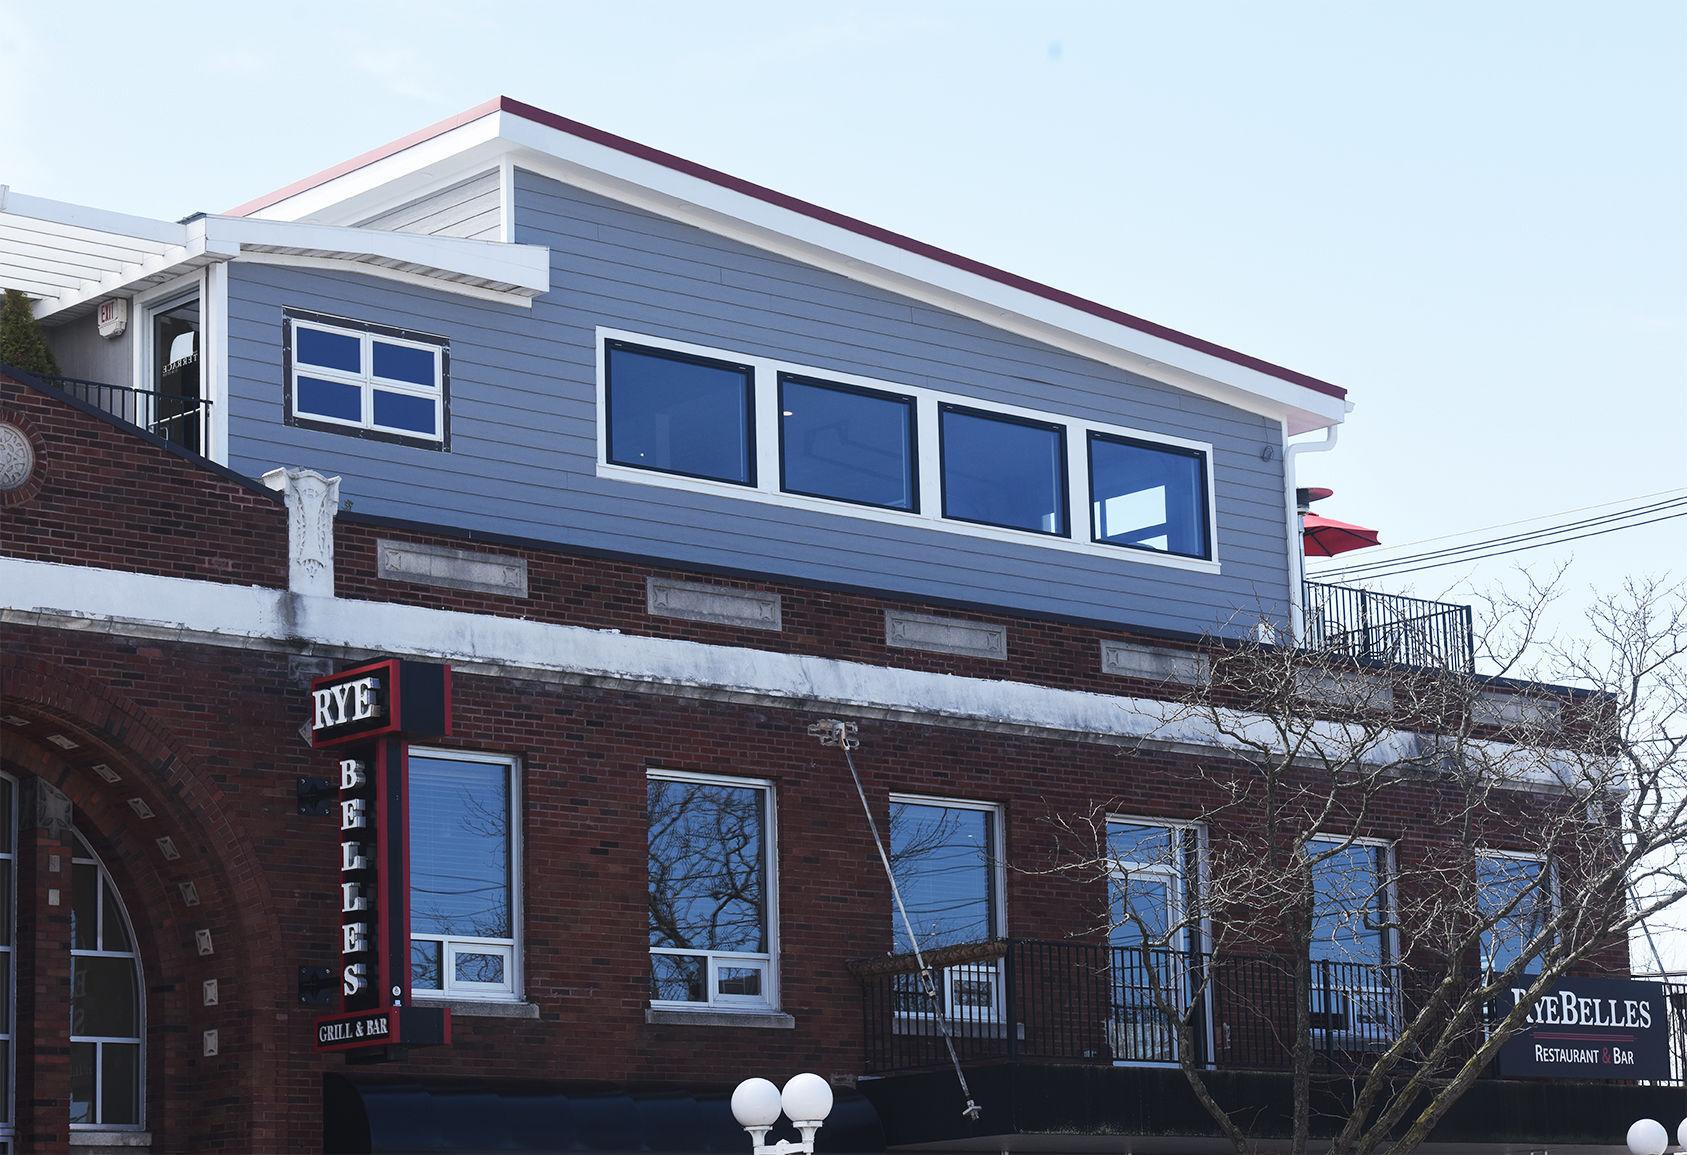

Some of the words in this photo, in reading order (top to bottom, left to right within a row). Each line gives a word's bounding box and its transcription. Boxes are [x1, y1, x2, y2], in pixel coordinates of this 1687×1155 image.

[101, 302, 114, 323] EXIT
[312, 677, 380, 730] RYE
[340, 759, 367, 996] BELLES
[319, 1022, 353, 1042] GRILL
[356, 1020, 364, 1038] &
[367, 1017, 389, 1035] BAR
[1602, 1046, 1611, 1065] &
